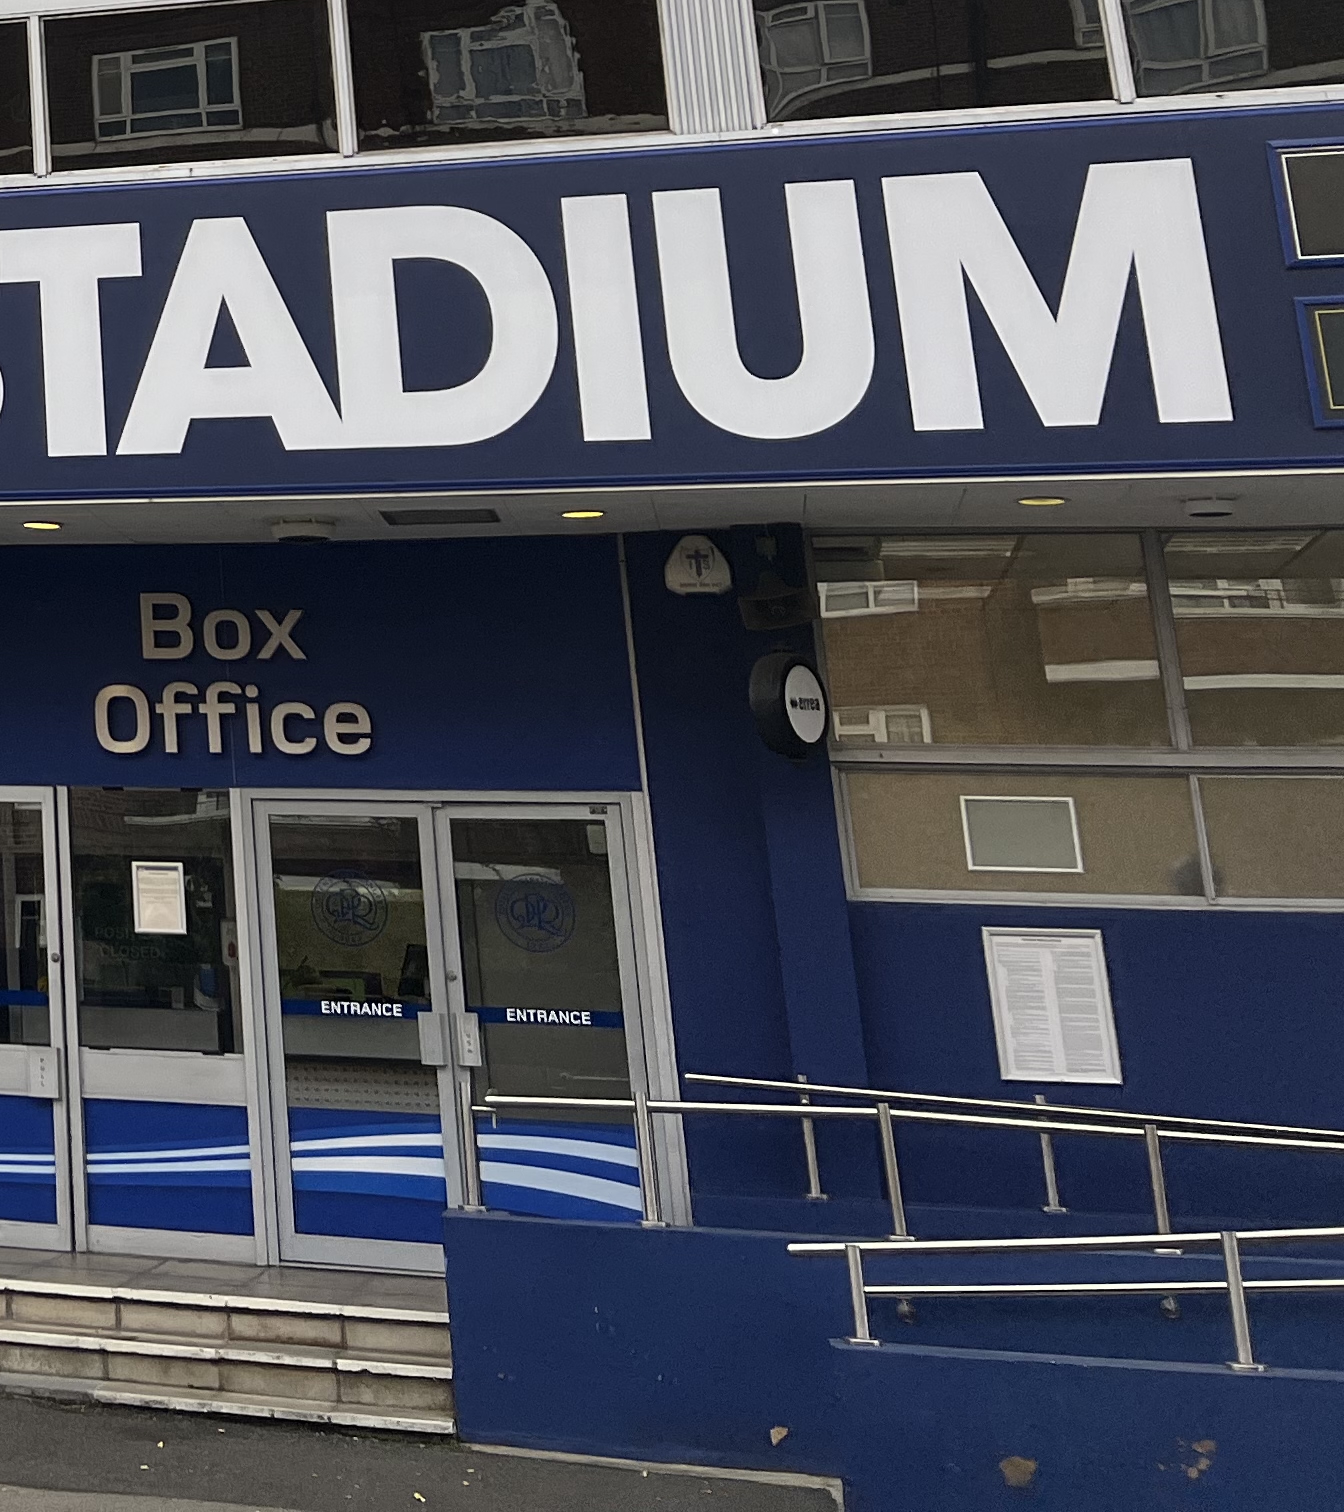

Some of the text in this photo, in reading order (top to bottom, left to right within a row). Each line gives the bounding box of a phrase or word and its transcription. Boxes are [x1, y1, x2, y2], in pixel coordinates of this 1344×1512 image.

[139, 592, 307, 660] Box
[94, 681, 372, 756] Office
[321, 1000, 403, 1017] ENTRANCE
[506, 1008, 592, 1026] ENTRANCE
